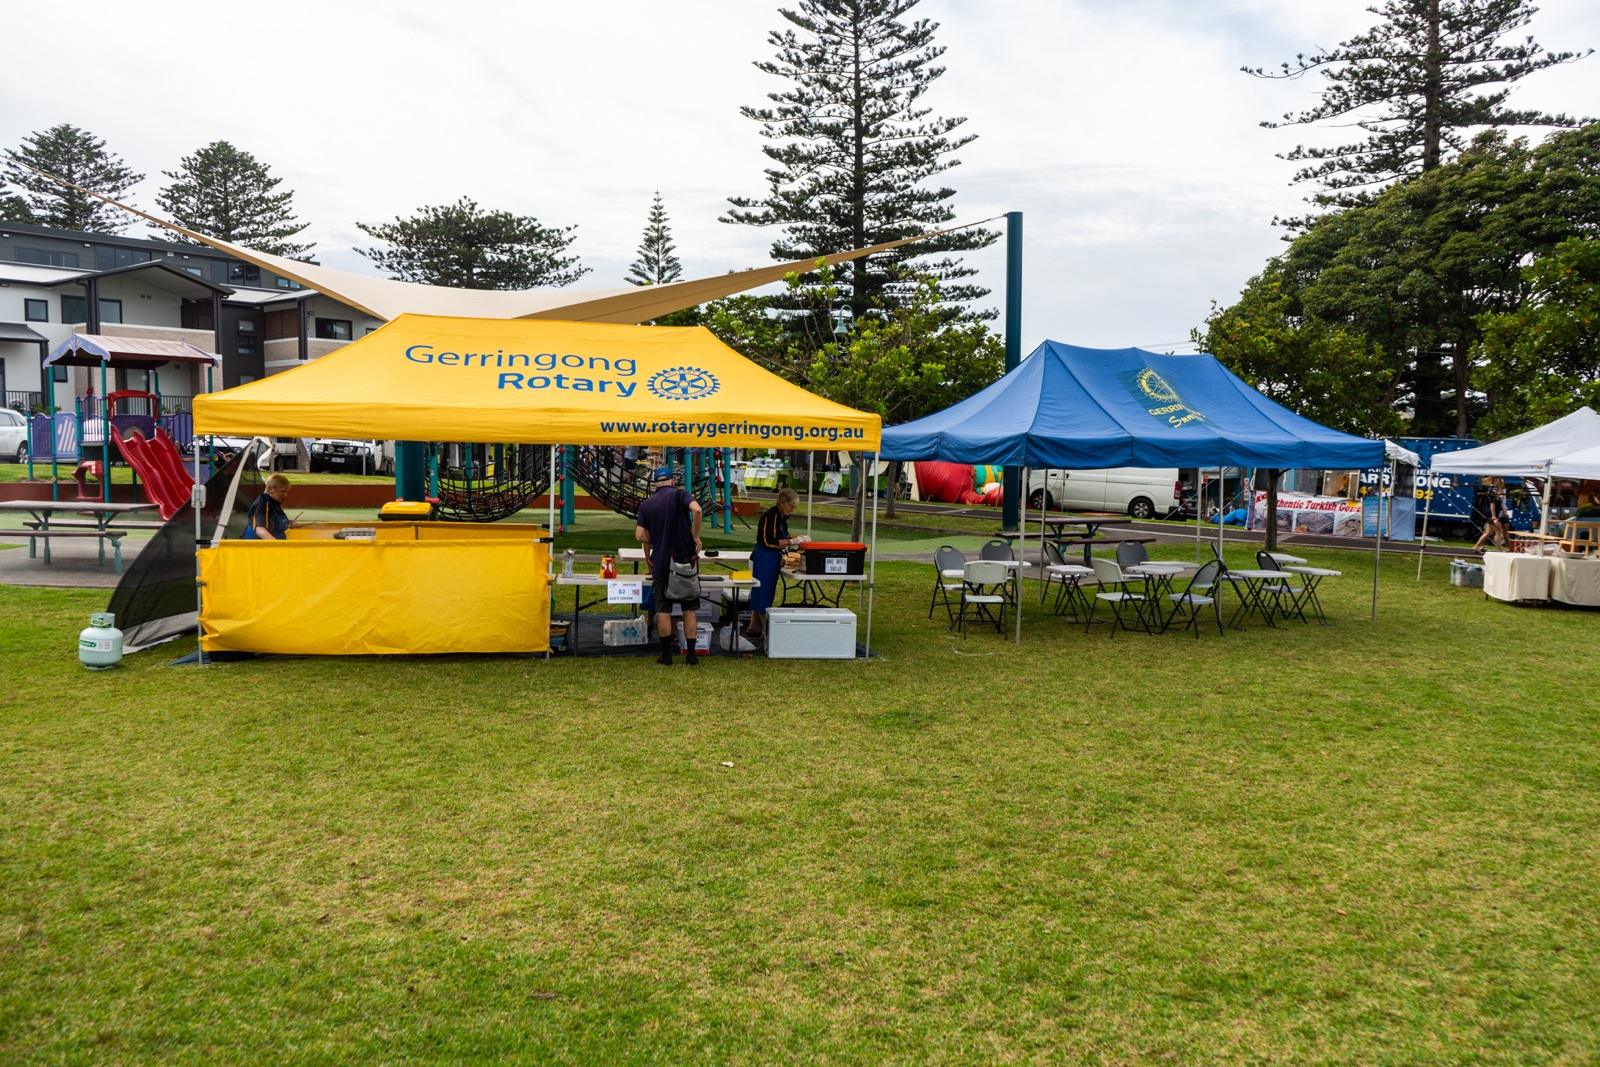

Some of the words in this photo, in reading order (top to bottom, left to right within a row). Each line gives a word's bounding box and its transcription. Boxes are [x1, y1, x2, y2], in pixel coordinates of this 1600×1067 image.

[406, 345, 637, 377] Gerringong
[497, 372, 637, 398] Rotary
[600, 420, 864, 442] www.rotarygerringong.org.au
[1305, 500, 1338, 512] Turkish
